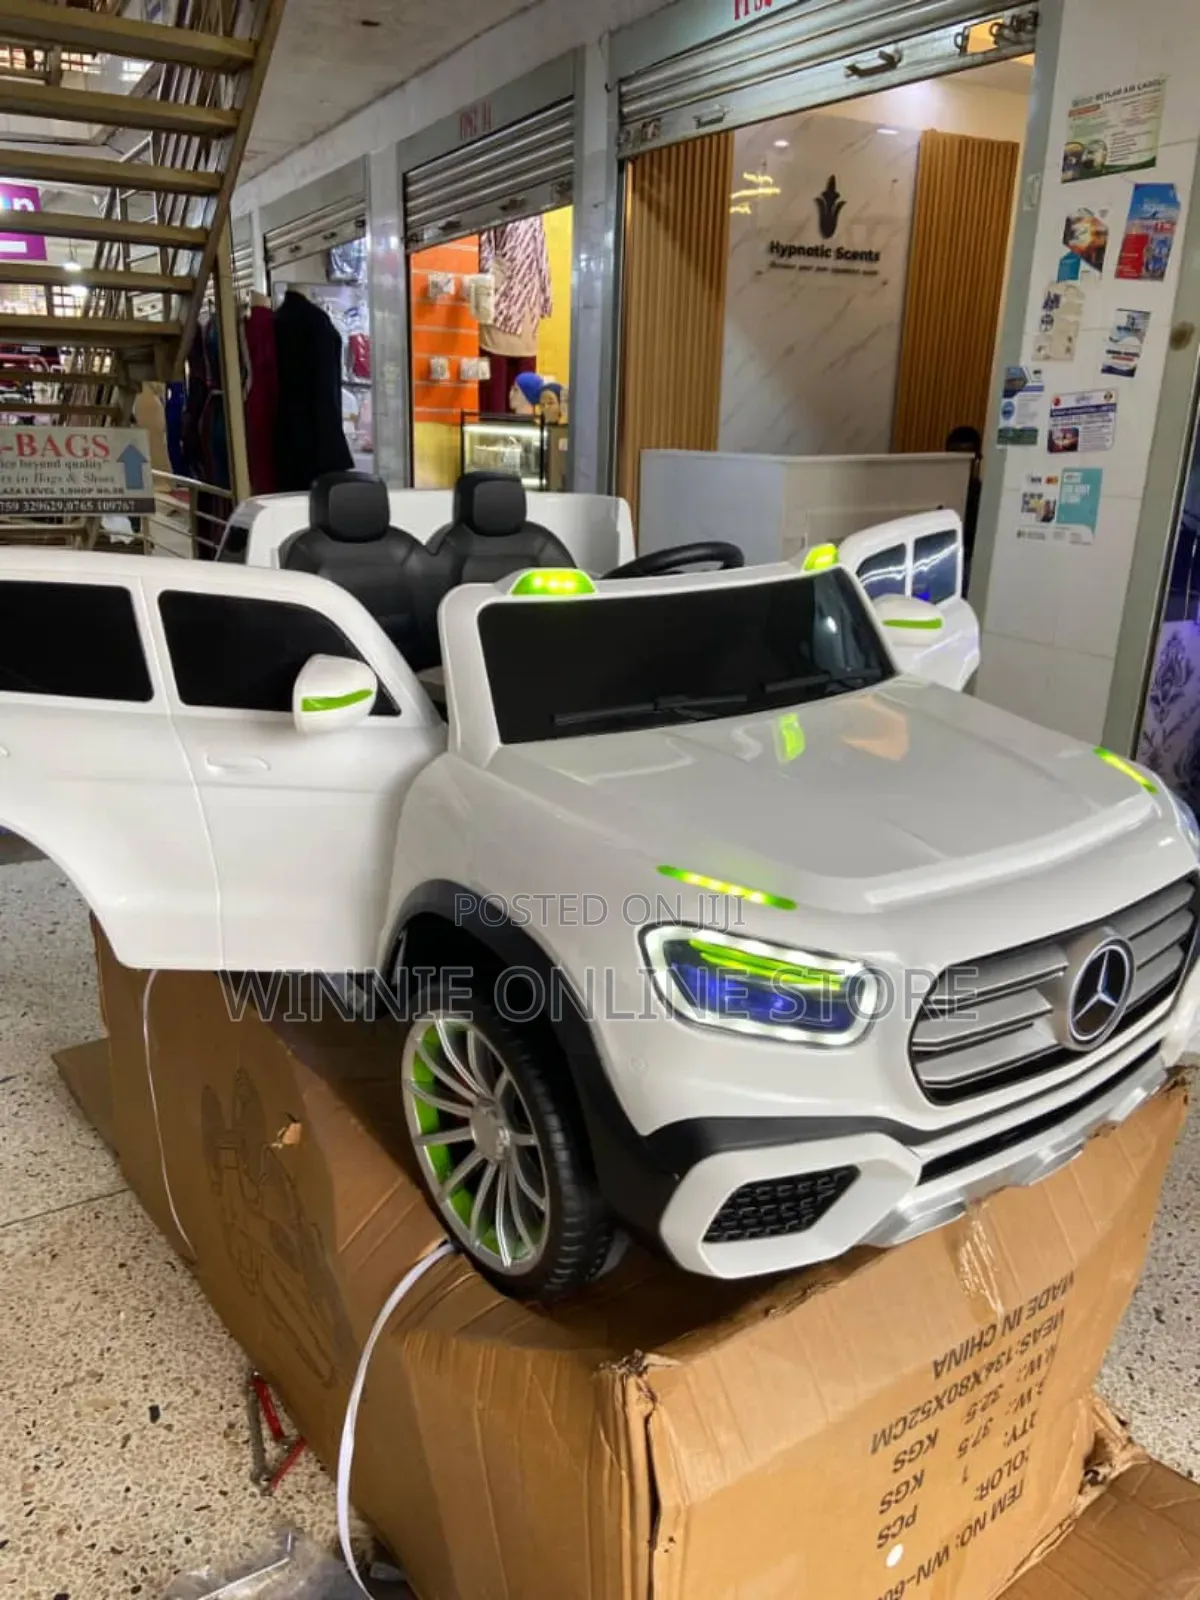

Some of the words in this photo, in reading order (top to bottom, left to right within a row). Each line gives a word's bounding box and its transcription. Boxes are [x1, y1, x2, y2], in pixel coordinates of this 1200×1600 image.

[768, 240, 832, 260] Hypnotic
[835, 246, 881, 262] Scents
[1002, 1305, 1023, 1337] IN
[933, 1323, 997, 1380] CHINA
[892, 1427, 939, 1474] KGS
[879, 1467, 925, 1515] KGS
[877, 1504, 918, 1549] PCS
[955, 1510, 987, 1548] NO:
